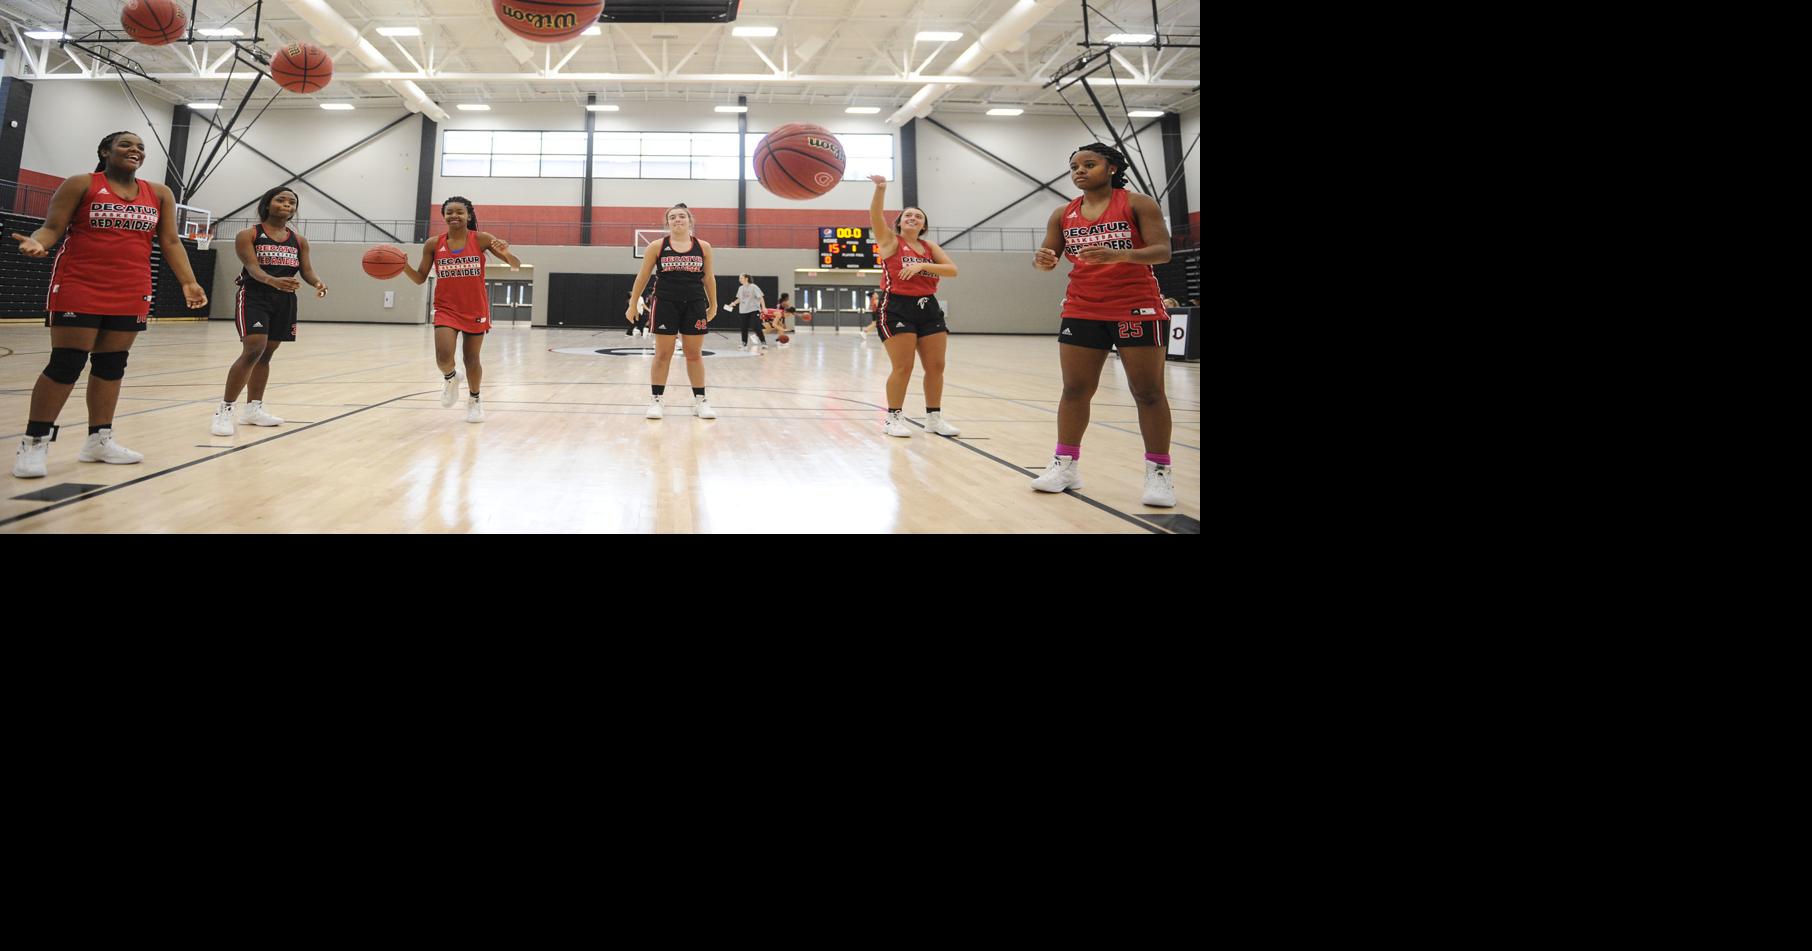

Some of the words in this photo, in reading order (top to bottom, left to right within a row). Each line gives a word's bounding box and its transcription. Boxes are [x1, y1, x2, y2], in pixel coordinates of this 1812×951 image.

[502, 5, 577, 29] Wilson
[91, 203, 158, 216] DECATUR
[90, 219, 113, 228] RED
[1063, 221, 1130, 238] DECATUR
[1066, 232, 1127, 244] BASKETBALL
[1118, 320, 1143, 338] 25
[1172, 327, 1184, 340] D
